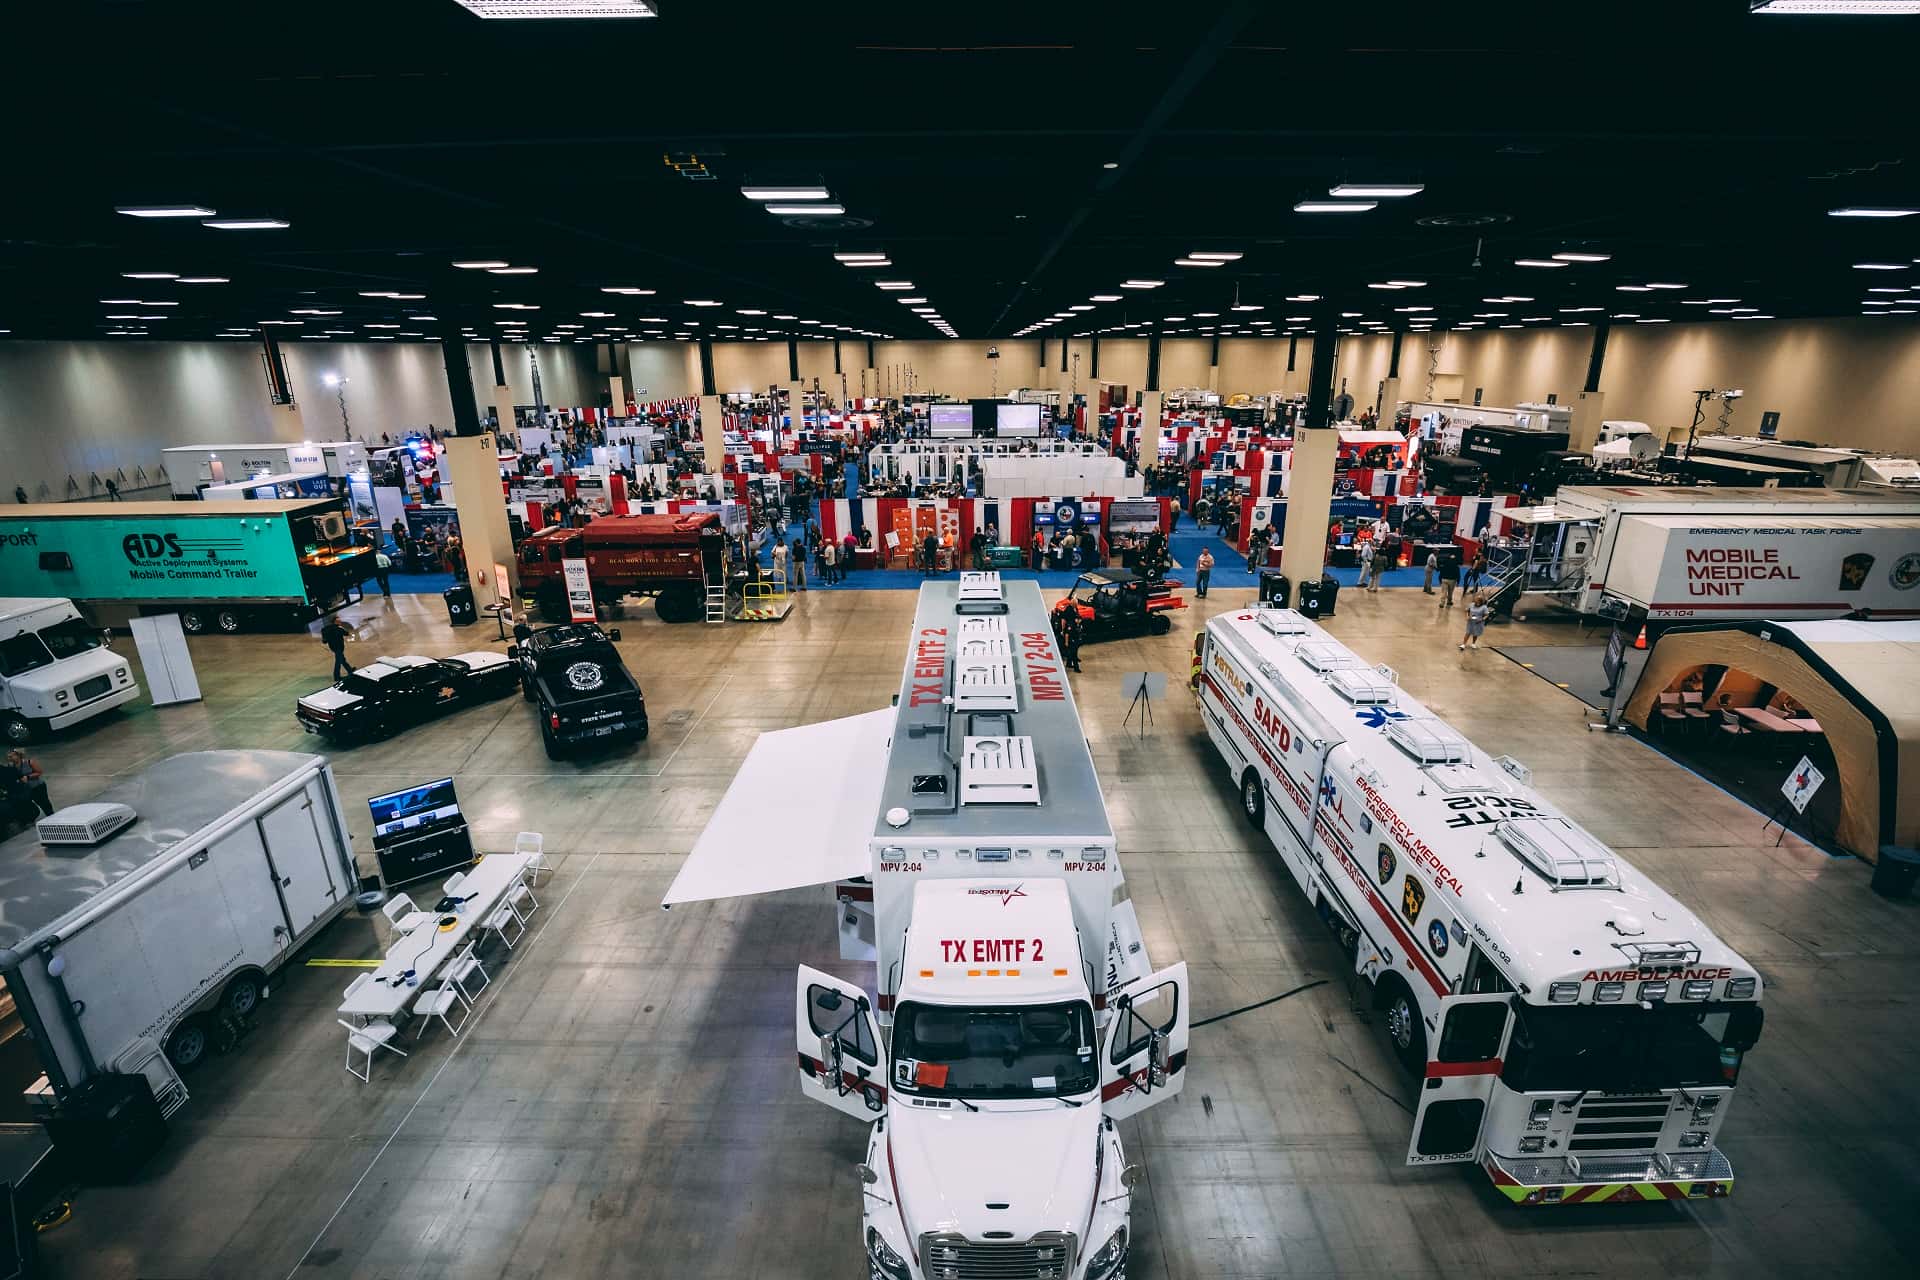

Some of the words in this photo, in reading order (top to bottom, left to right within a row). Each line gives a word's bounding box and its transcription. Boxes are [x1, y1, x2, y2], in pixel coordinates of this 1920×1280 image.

[122, 532, 184, 566] ADS
[1686, 549, 1779, 563] MOBILE
[129, 569, 166, 580] Mobile
[167, 569, 222, 580] Command
[222, 568, 258, 578] Trailer
[136, 559, 161, 567] Active
[163, 559, 211, 568] Deployment
[213, 558, 249, 568] Systems
[1688, 566, 1800, 580] MEDICAL
[1688, 582, 1745, 596] UNIT
[928, 627, 948, 636] 2
[914, 638, 946, 678] EMTF
[1020, 632, 1055, 661] 2-04
[909, 683, 944, 708] TX
[1029, 666, 1066, 702] MPV
[1254, 696, 1291, 752] SAFD
[1270, 761, 1310, 818] EVACUATIO
[1355, 776, 1414, 839] EMERGENCY
[1413, 839, 1464, 898] MEDICAL
[1365, 797, 1389, 828] TASK
[1390, 826, 1424, 868] FORCE
[1434, 876, 1444, 889] 8
[880, 862, 900, 872] MPV
[902, 862, 922, 872] 2-04
[1064, 862, 1084, 872] MPV
[1085, 862, 1106, 872] 2-04
[1315, 822, 1370, 900] AMBULANCE
[940, 940, 966, 962] TX
[973, 940, 1025, 962] EMTF
[1032, 939, 1044, 962] 2
[1474, 923, 1490, 943] MPV
[1491, 941, 1512, 966] 8-02
[1583, 968, 1732, 982] AMBULANCE
